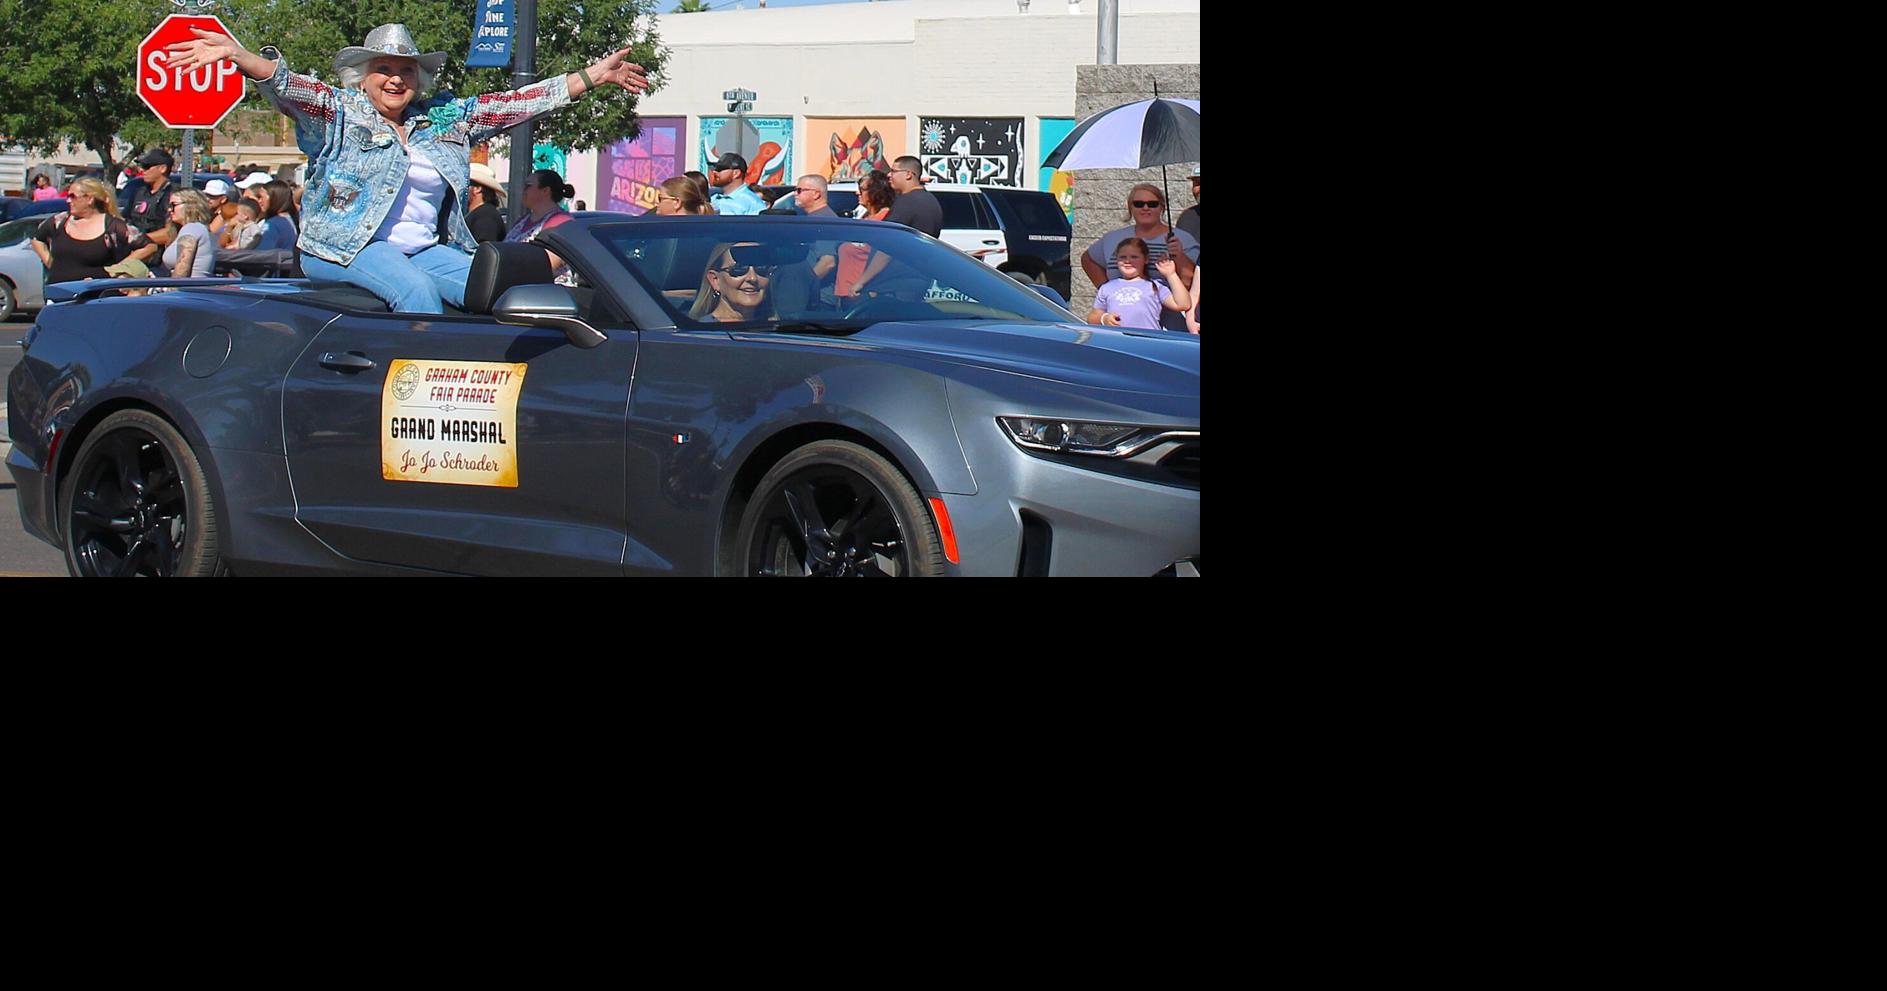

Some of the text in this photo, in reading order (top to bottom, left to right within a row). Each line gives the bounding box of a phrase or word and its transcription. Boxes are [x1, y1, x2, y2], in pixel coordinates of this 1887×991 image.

[145, 50, 238, 92] STOP
[425, 368, 469, 384] GRAHAM
[470, 369, 512, 385] COUNTY
[430, 386, 498, 404] FAIR PARADE
[391, 417, 506, 444] GRAND MARSHAL
[400, 449, 499, 473] Jo Jo Schroder
